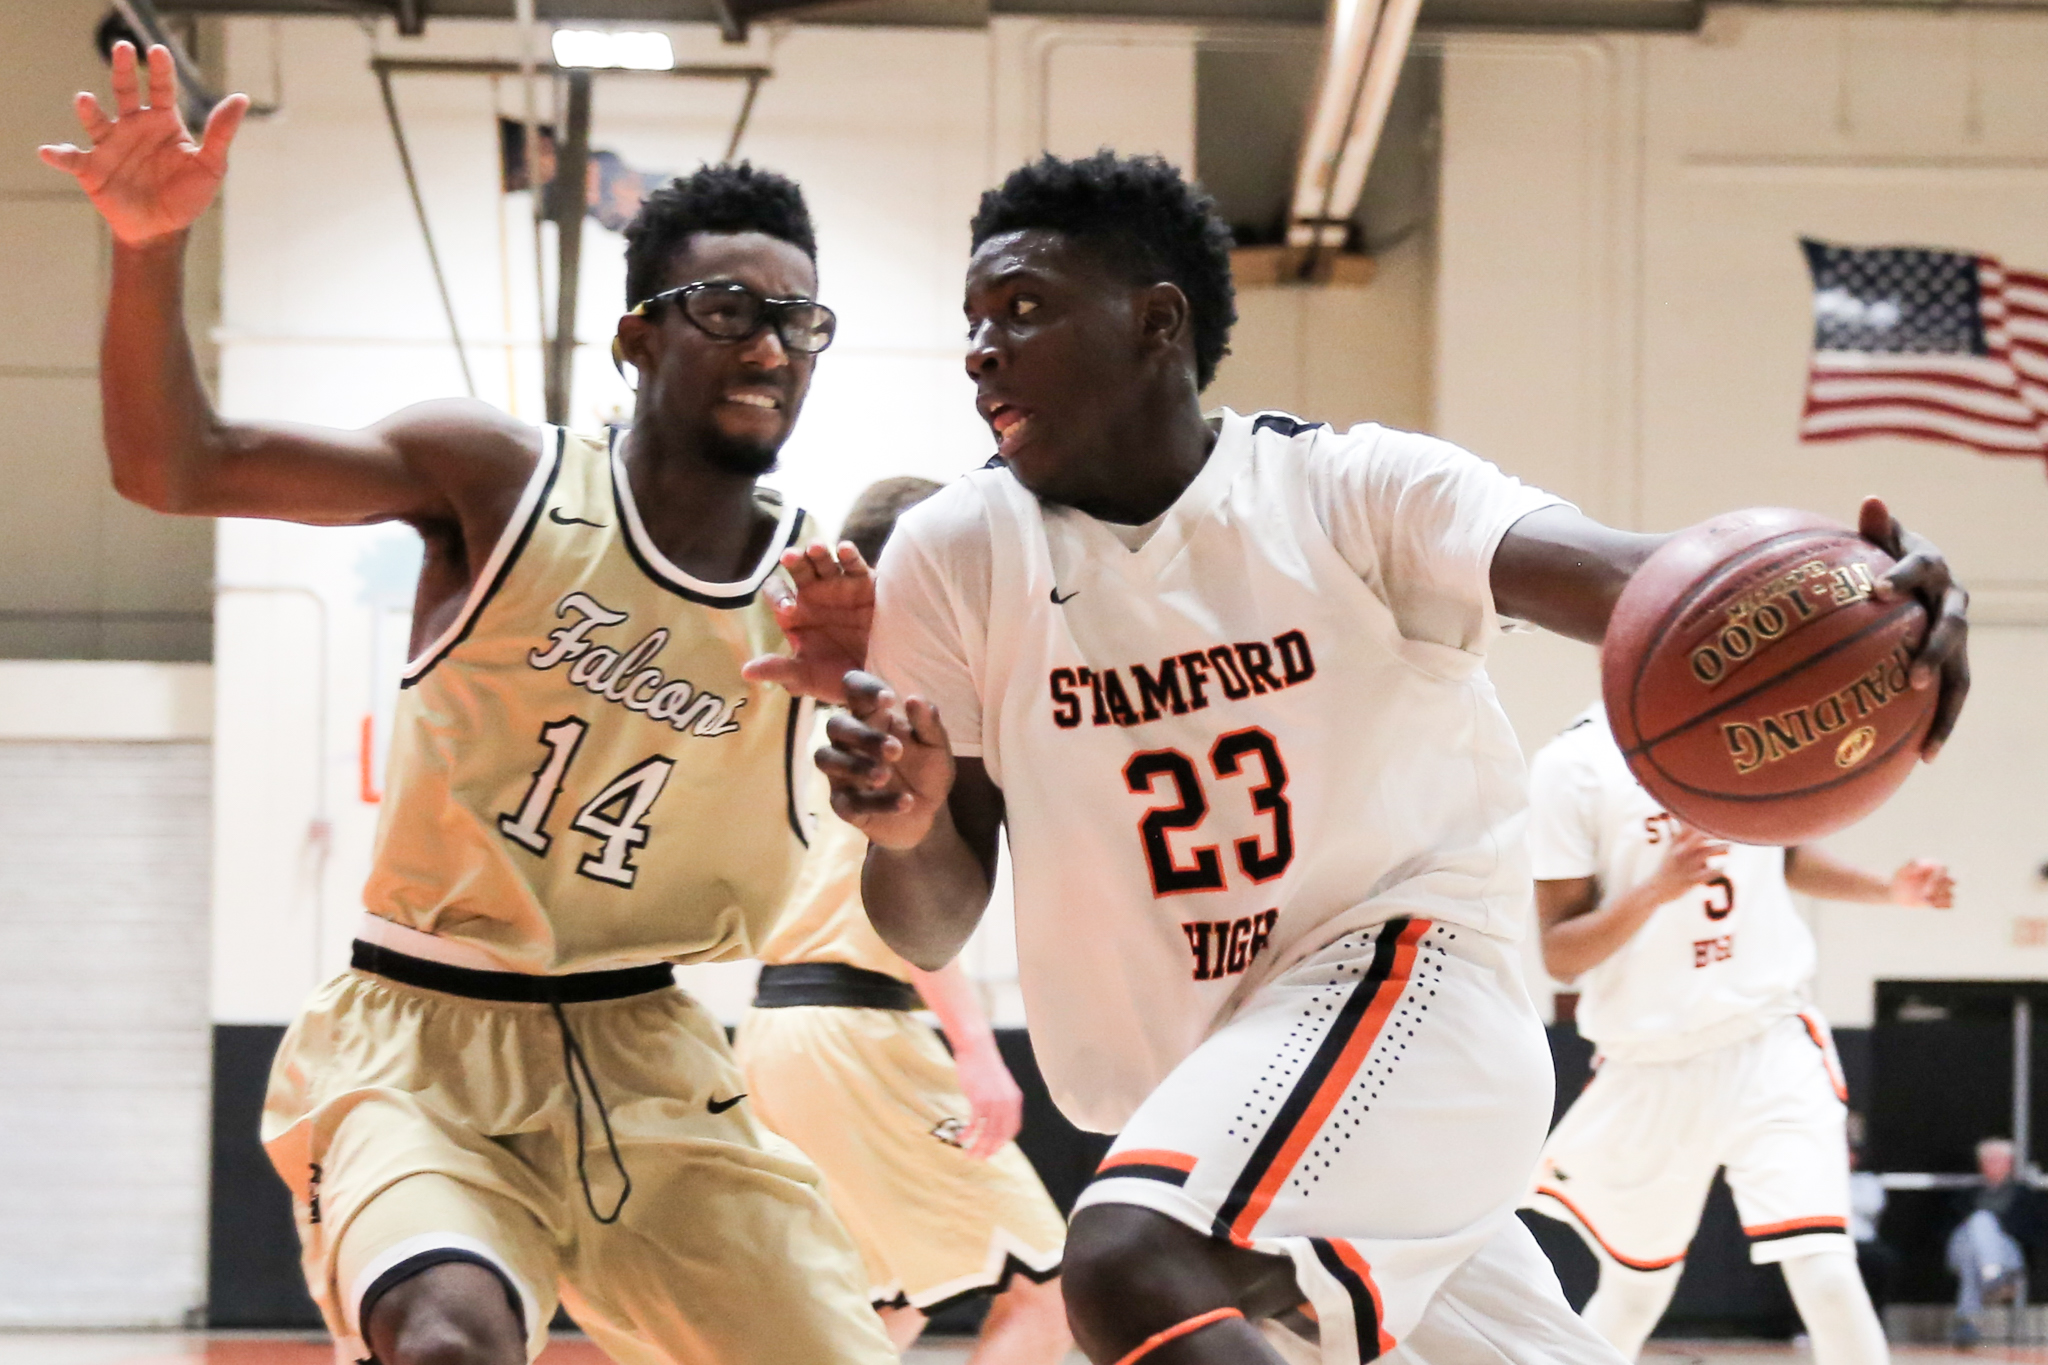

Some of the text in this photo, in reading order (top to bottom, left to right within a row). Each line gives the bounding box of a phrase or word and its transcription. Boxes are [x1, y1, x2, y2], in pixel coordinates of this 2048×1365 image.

[1049, 628, 1316, 729] STAMFORD
[1721, 646, 1911, 775] PALDING
[498, 715, 677, 890] 14
[1121, 725, 1295, 900] 23
